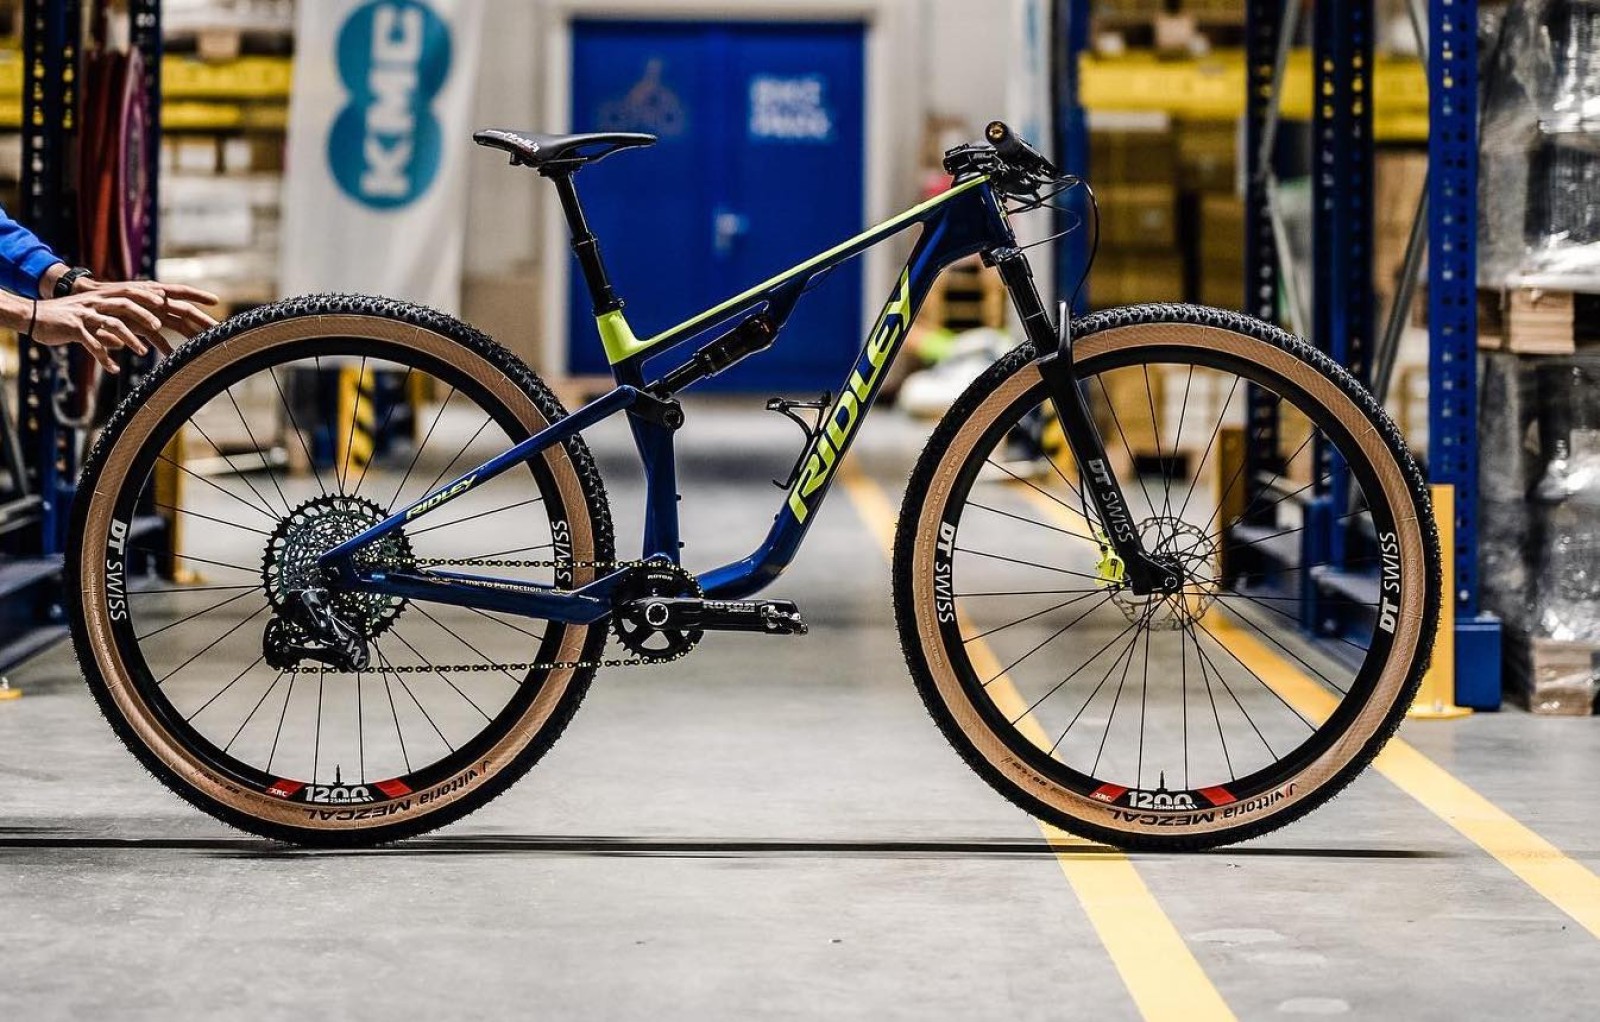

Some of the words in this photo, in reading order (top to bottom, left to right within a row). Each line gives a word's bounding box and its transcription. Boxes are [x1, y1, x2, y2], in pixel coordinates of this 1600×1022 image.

[360, 4, 424, 197] KMC
[788, 265, 911, 524] RIDLEY
[406, 474, 477, 520] RIDLEY
[1088, 458, 1112, 486] DT
[1102, 491, 1134, 543] SWISS
[108, 518, 128, 556] DT
[937, 521, 957, 557] DT
[1379, 532, 1400, 593] SWISS
[106, 559, 127, 621] SWISS
[935, 561, 954, 623] SWISS
[1379, 597, 1399, 634] DT
[305, 786, 370, 803] 1200
[420, 771, 478, 804] vittoria
[1128, 791, 1194, 809] 1200
[1223, 791, 1284, 819] vittoria
[303, 799, 411, 821] MEZCAL
[1107, 807, 1215, 827] MEZCAL
